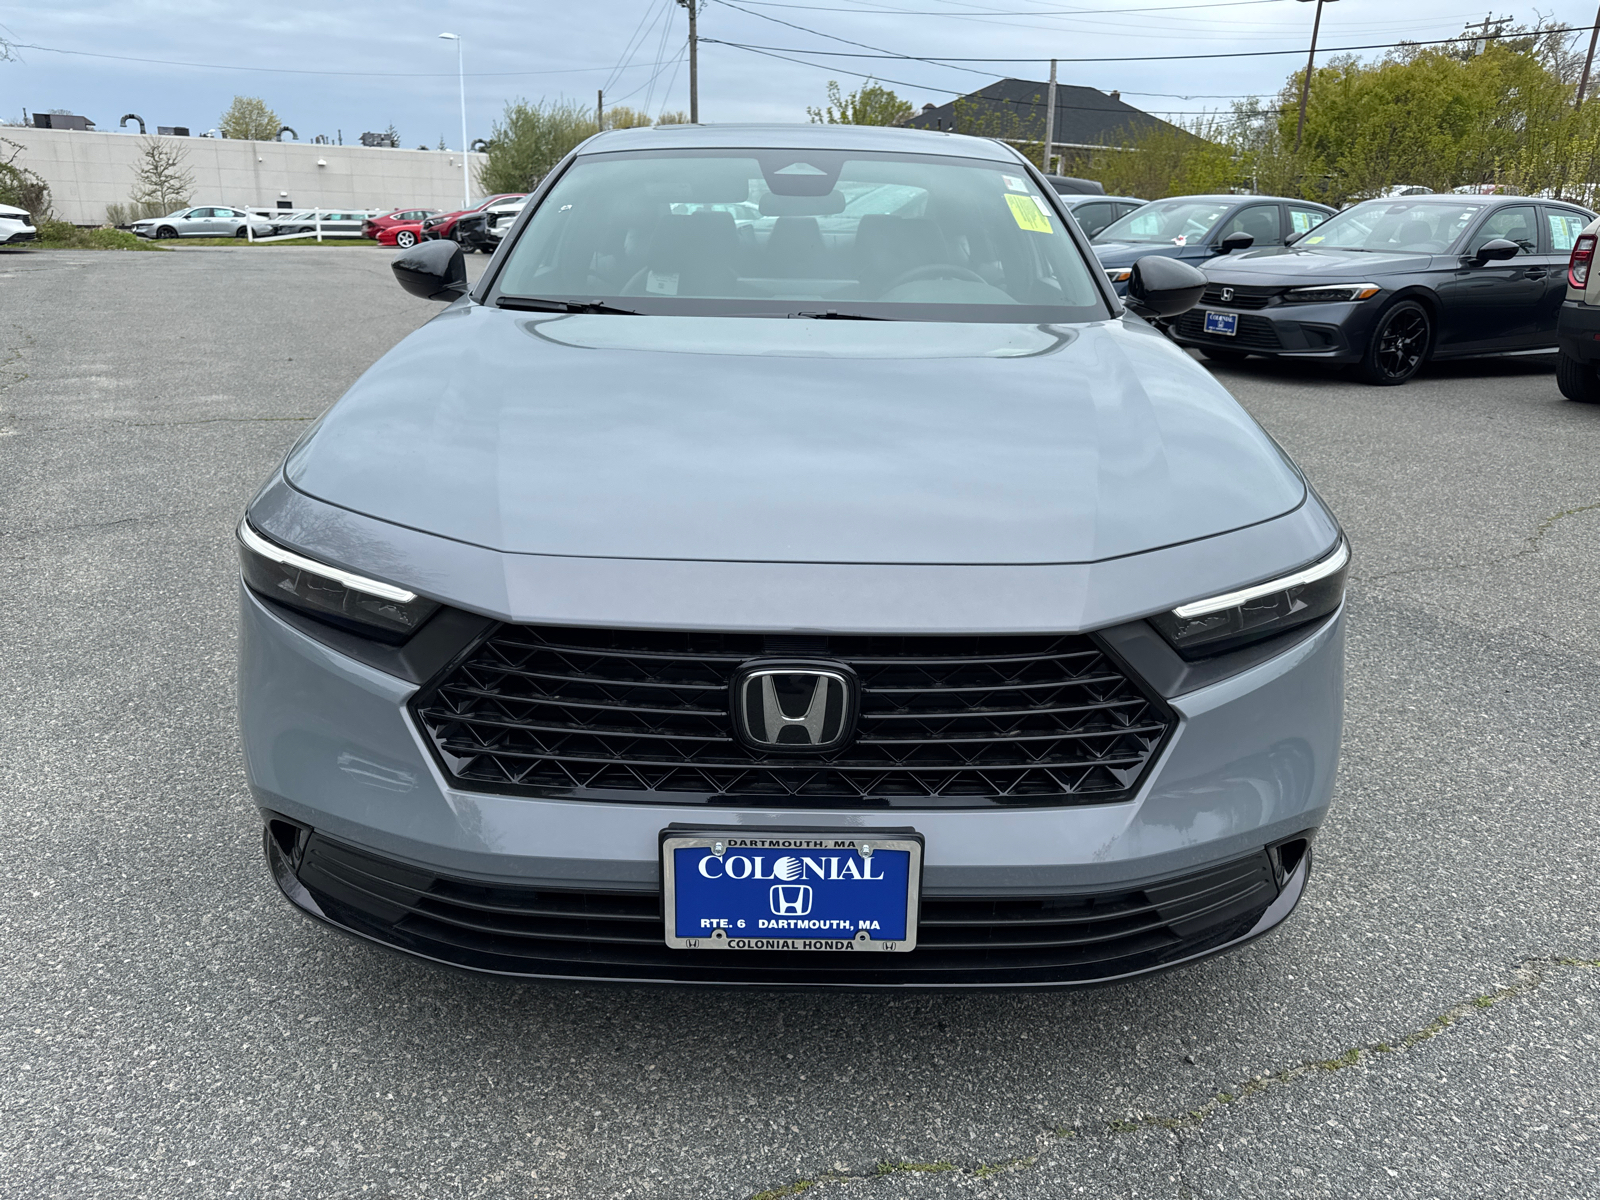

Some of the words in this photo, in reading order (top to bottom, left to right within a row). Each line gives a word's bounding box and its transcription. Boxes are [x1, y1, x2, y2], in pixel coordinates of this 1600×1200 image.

[727, 839, 828, 848] DARTMOUTH,
[833, 840, 856, 848] MA
[698, 855, 884, 881] COLONIAL
[700, 918, 733, 929] RTE.
[736, 919, 746, 929] 6
[758, 919, 854, 931] DARTMOUTH,
[858, 920, 881, 930] MA
[727, 939, 798, 950] COLONIAL
[802, 940, 854, 950] HONDA
